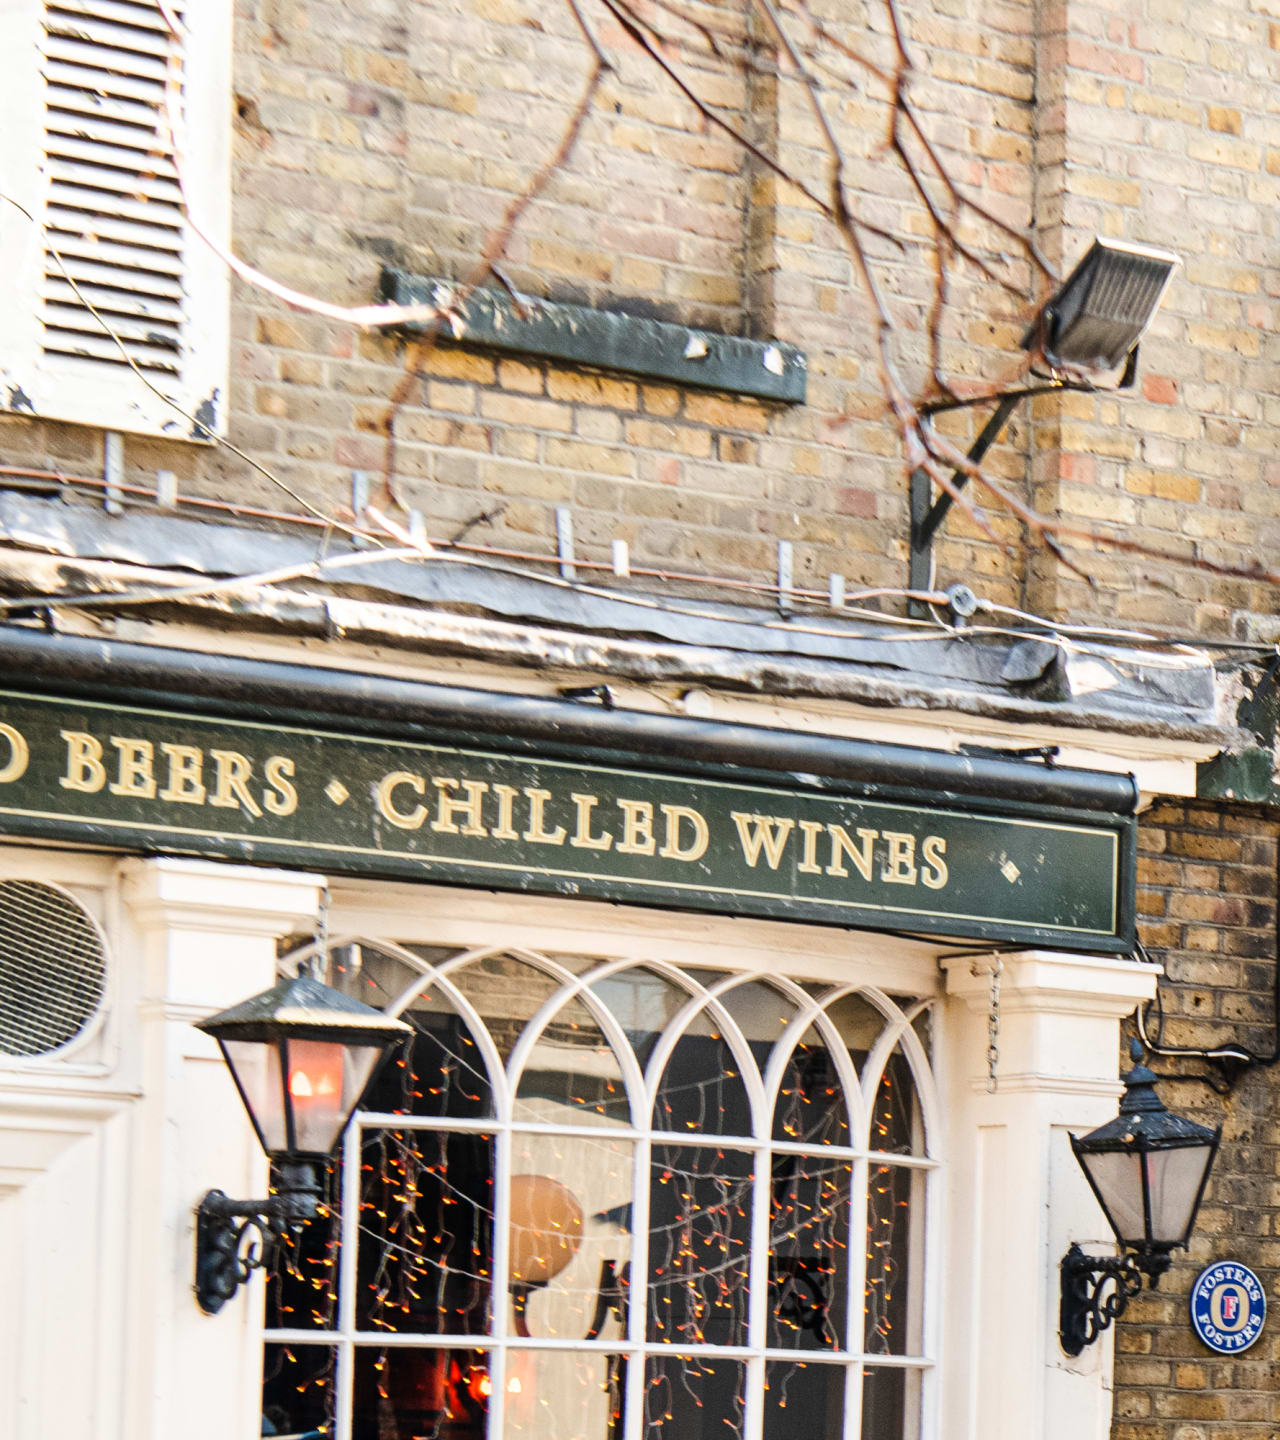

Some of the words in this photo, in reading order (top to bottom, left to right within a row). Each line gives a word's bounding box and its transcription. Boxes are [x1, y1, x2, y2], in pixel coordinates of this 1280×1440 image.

[59, 729, 299, 818] BEERS
[376, 771, 710, 862] CHILLED
[730, 810, 950, 890] WINES
[1198, 1266, 1261, 1302] FOSTER'S
[1198, 1312, 1261, 1348] FOSTER'S
